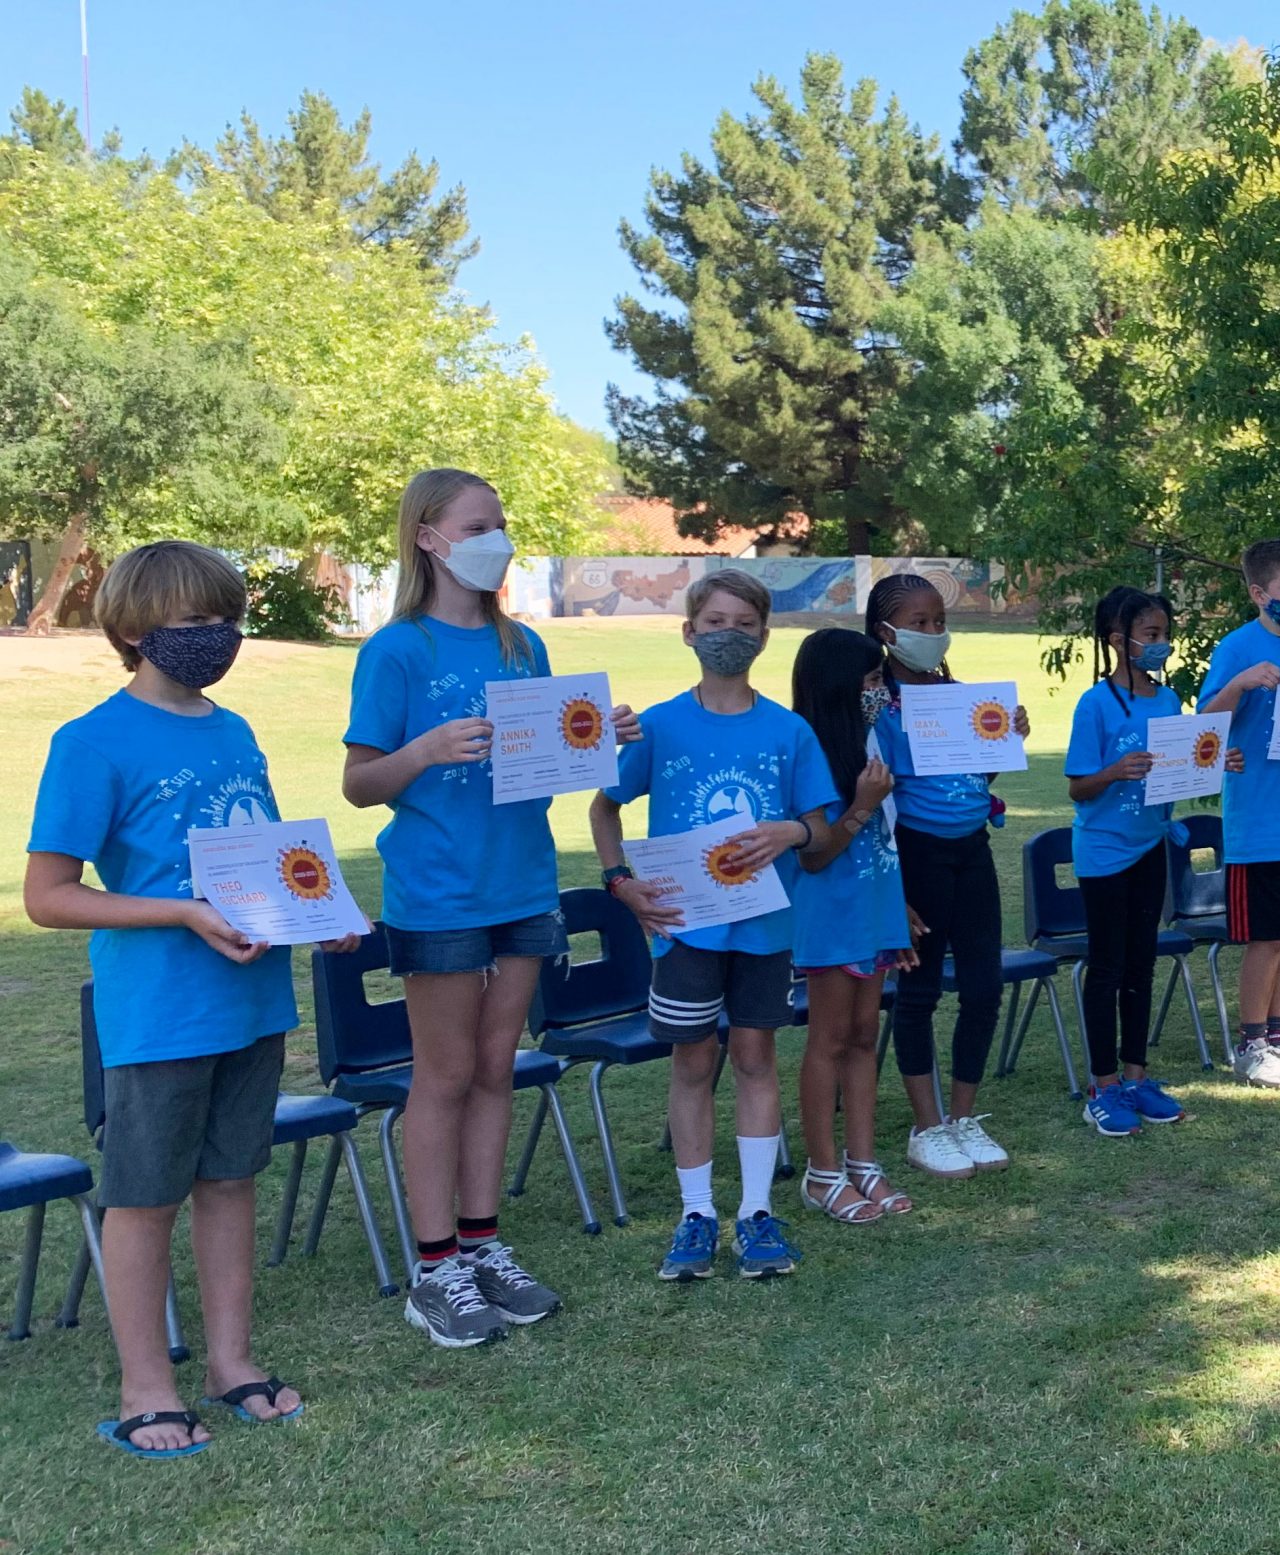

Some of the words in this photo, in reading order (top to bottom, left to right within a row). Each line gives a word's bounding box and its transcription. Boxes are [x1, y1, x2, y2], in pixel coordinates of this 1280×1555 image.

[589, 573, 600, 584] 66
[439, 673, 460, 690] SEED
[500, 728, 536, 742] ANNIKA
[500, 742, 531, 755] SMITH
[156, 787, 178, 801] THE
[171, 768, 195, 788] SEED
[212, 880, 242, 894] THEO
[648, 875, 676, 887] NOAH
[219, 891, 267, 905] RICHARD
